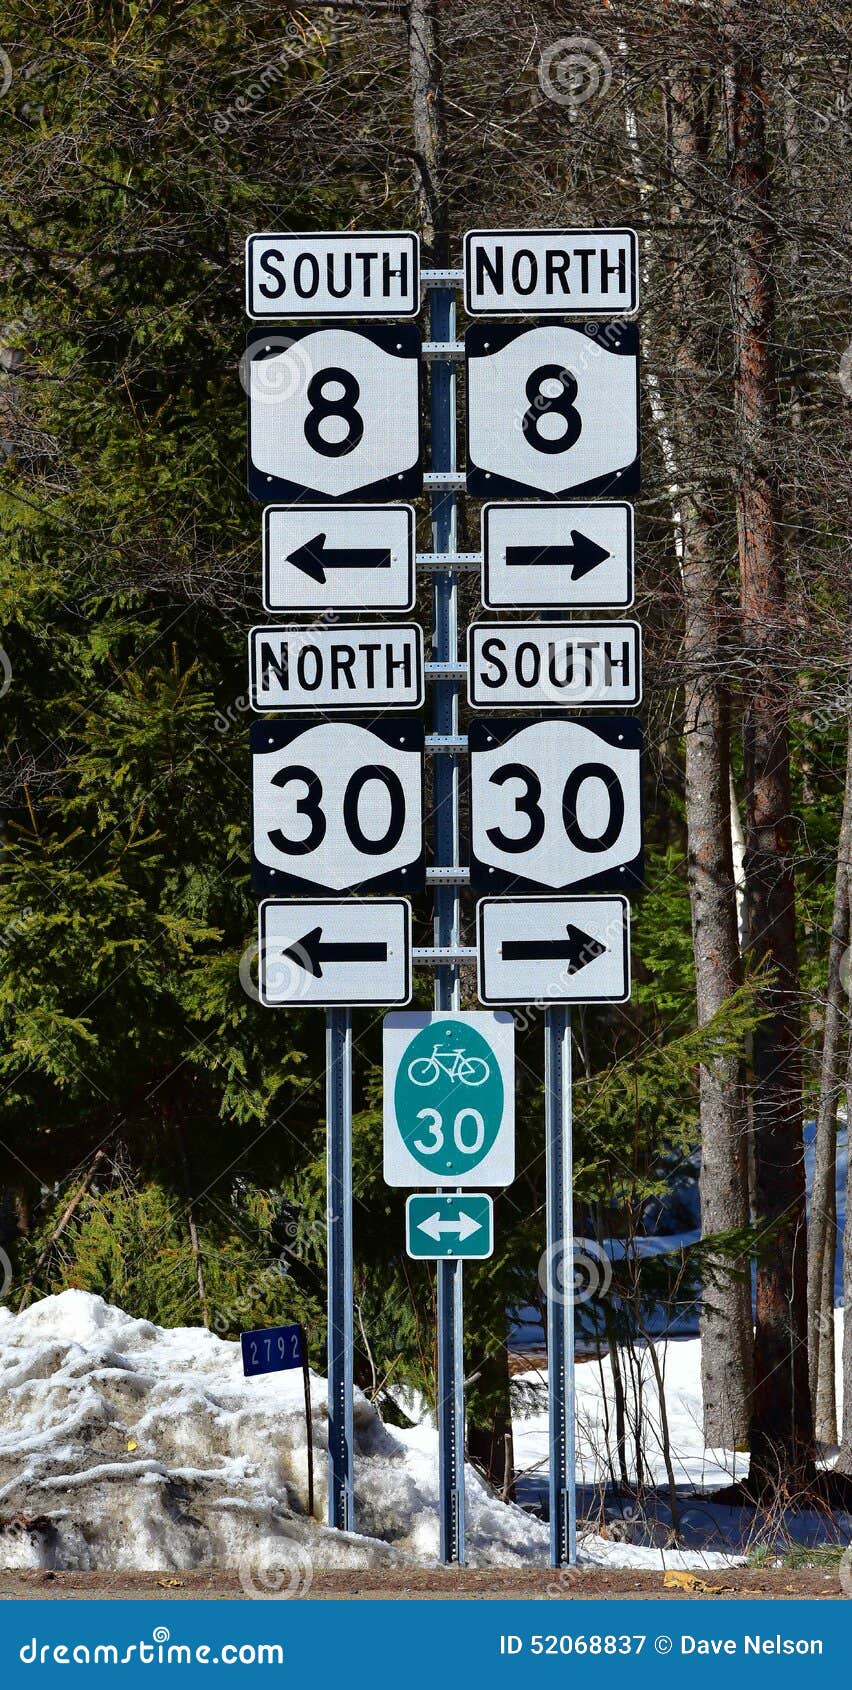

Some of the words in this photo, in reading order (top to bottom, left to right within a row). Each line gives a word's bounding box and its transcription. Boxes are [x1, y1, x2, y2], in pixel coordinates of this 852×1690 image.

[259, 249, 407, 299] SOUTH
[476, 246, 626, 295] NORTH
[304, 367, 363, 457] 8
[522, 364, 582, 454] 8
[261, 642, 411, 691] NORTH
[480, 638, 629, 688] SOUTH
[268, 765, 405, 855] 30
[486, 763, 624, 853] 30
[414, 1108, 484, 1154] 30
[250, 1335, 299, 1364] 2792
